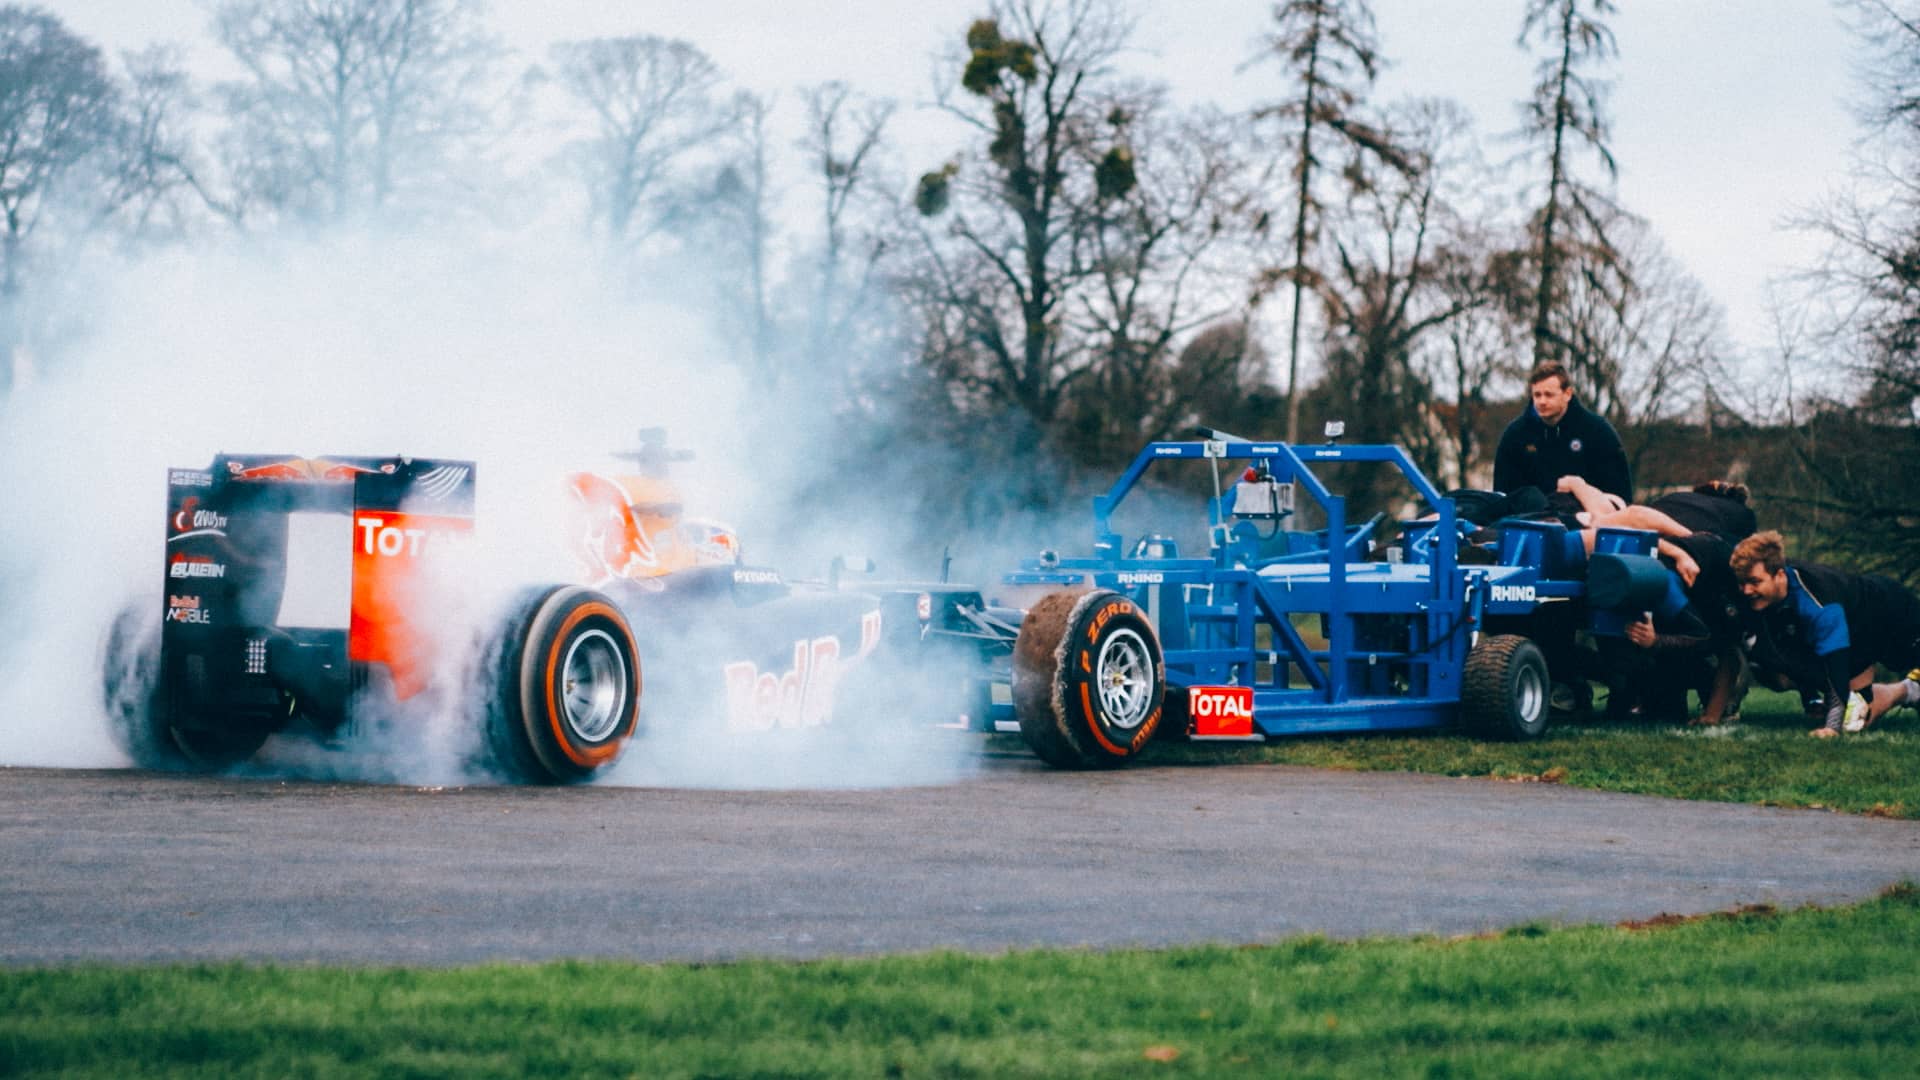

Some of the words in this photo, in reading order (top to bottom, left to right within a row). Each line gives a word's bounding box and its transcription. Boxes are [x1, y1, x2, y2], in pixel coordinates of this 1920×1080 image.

[358, 518, 450, 556] TOT
[1117, 573, 1164, 584] RHINO
[1491, 585, 1536, 602] RHINO
[1087, 602, 1133, 645] ZERO
[1190, 687, 1253, 717] TOTAL
